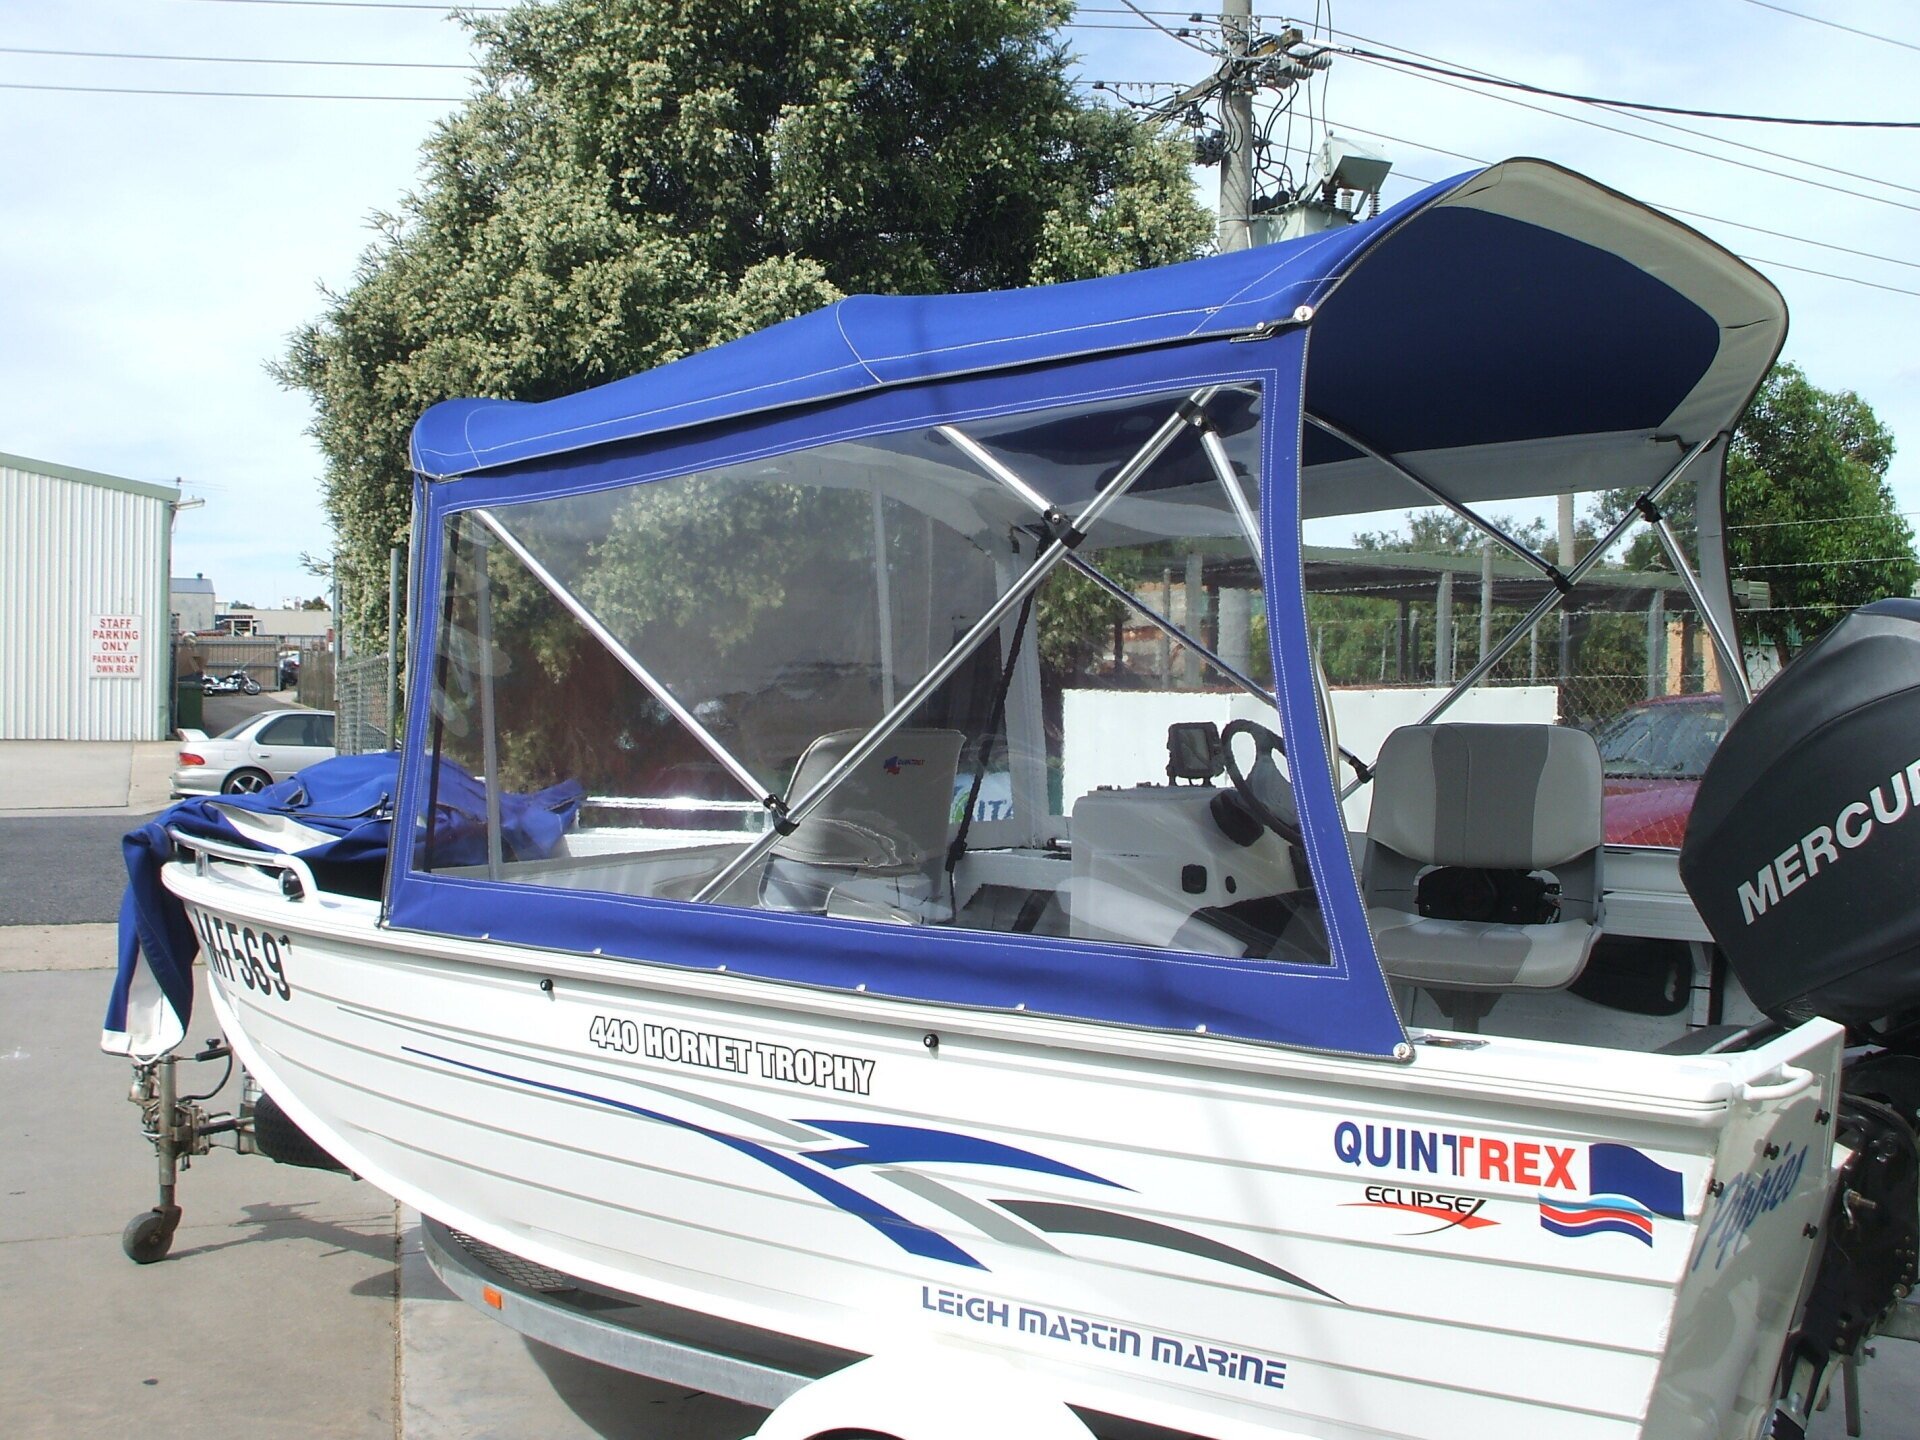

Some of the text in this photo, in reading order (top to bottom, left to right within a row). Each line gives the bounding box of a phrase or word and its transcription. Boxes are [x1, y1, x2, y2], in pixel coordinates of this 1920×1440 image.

[100, 618, 132, 629] STAFF
[92, 630, 139, 640] PARKING
[102, 641, 129, 651] ONLY
[92, 655, 139, 664] PARKING AT
[96, 664, 135, 673] OWN RISK
[589, 1015, 876, 1096] 440 HORNET TROPHY
[1334, 1120, 1577, 1191] QUINTREX
[1364, 1185, 1477, 1214] ECLIPSE
